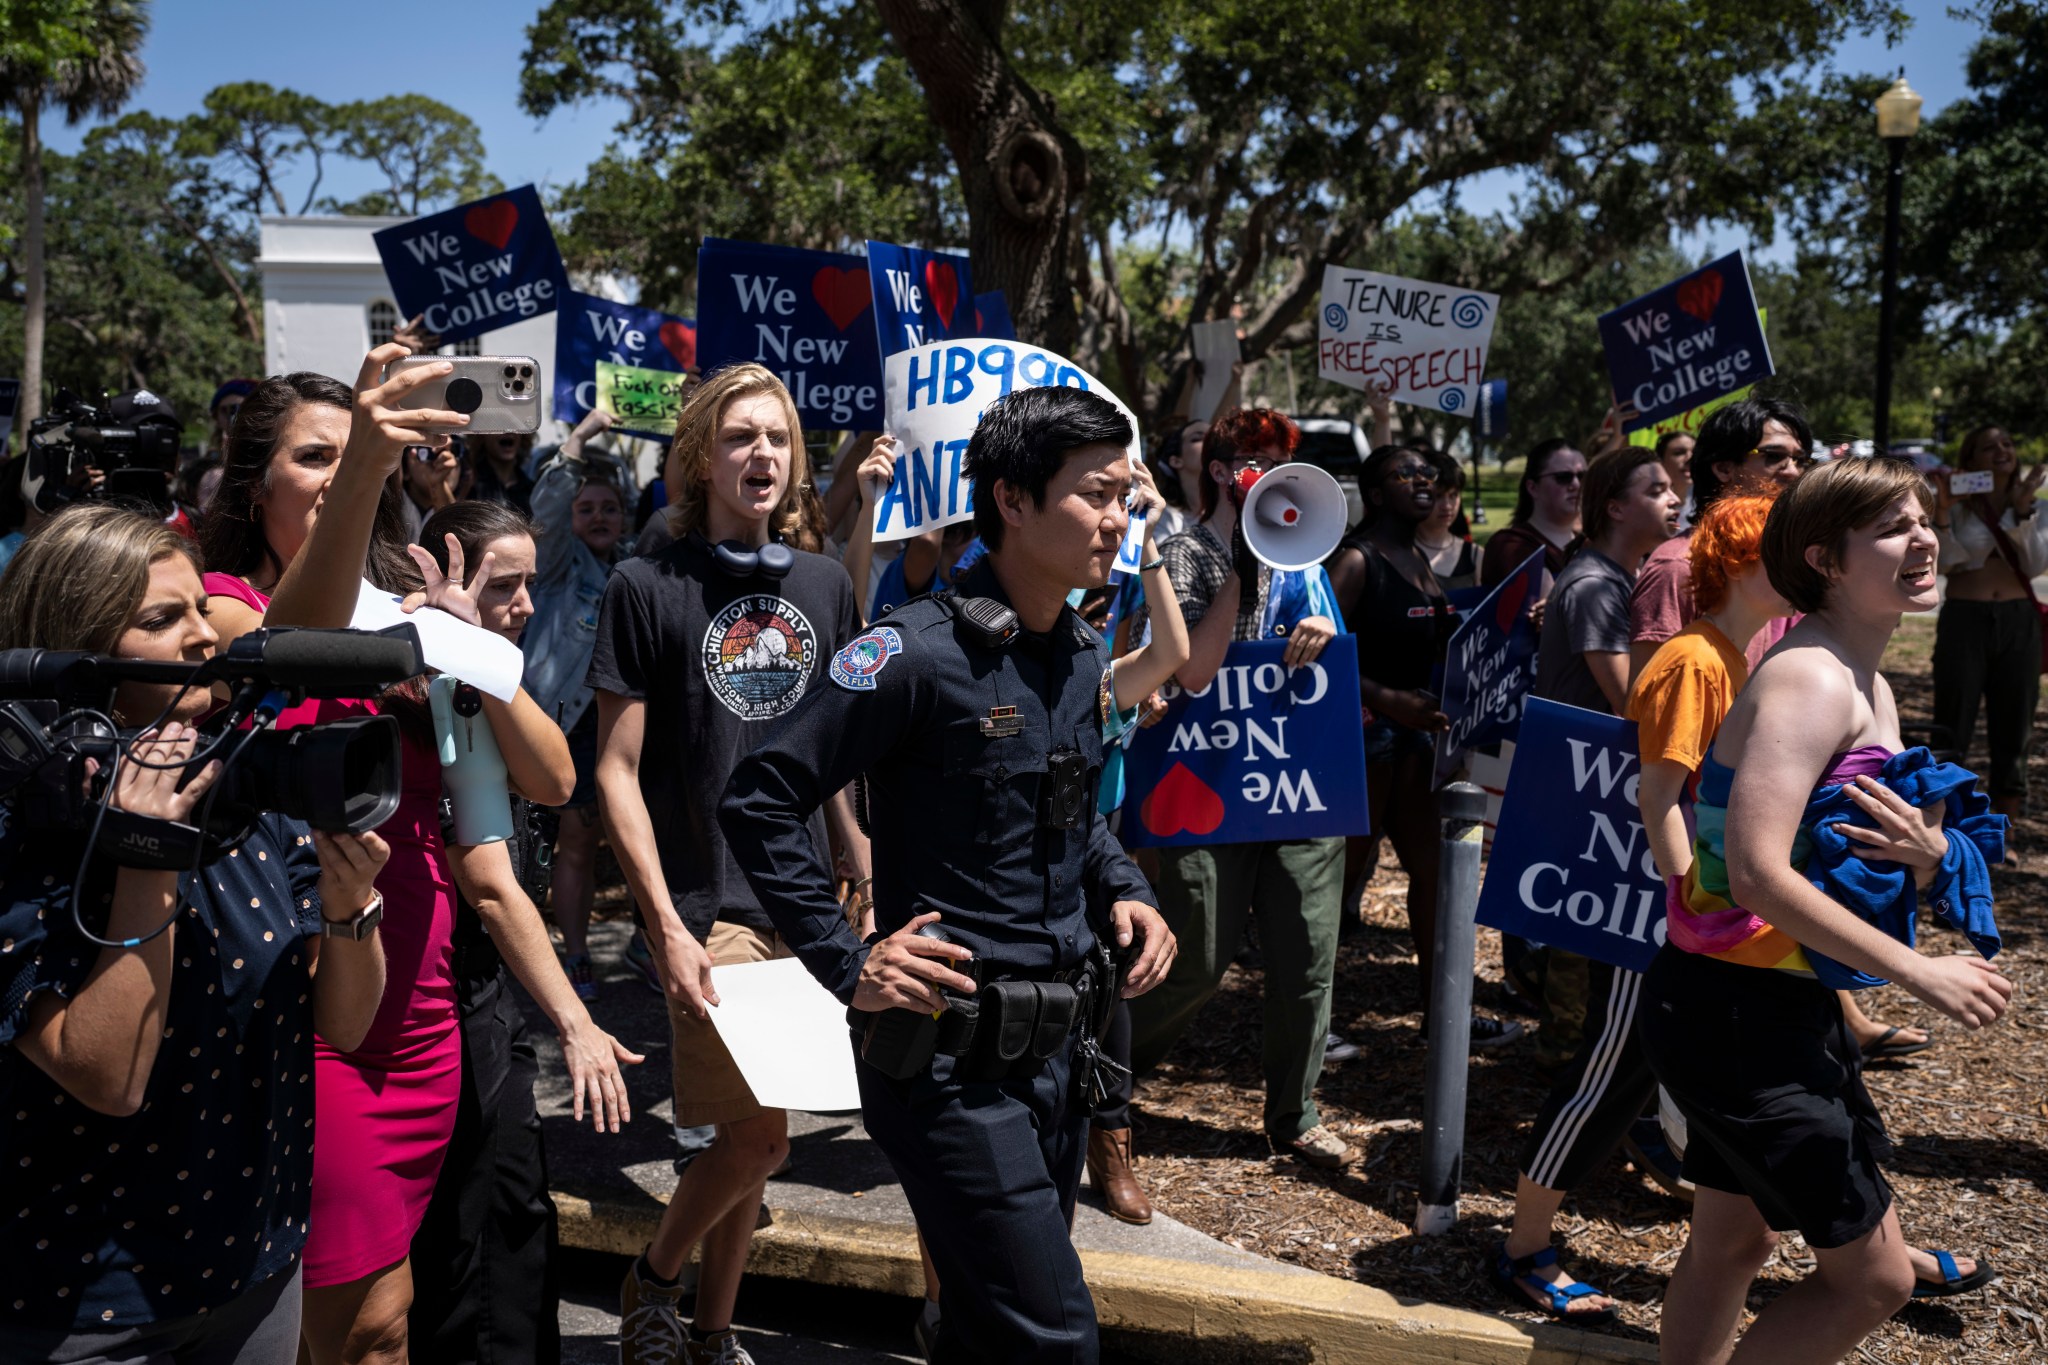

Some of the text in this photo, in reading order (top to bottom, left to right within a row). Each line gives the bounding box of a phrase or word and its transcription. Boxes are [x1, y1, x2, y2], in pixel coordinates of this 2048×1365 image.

[402, 230, 460, 266] We
[434, 253, 513, 295] New
[730, 273, 796, 315] We
[885, 269, 922, 314] We
[424, 278, 554, 333] College
[1343, 278, 1446, 327] TENURE
[586, 310, 646, 351] We
[754, 323, 849, 365] New
[1367, 322, 1402, 341] IS
[1621, 309, 1671, 345] We
[1646, 325, 1716, 373] New
[1320, 338, 1481, 393] FREE SPEECH
[1633, 349, 1751, 413] College
[780, 370, 877, 423] llege
[876, 439, 974, 533] ANT
[707, 600, 754, 665] CHIEFTON
[758, 599, 807, 633] SUPPLY
[1461, 624, 1489, 671] We
[715, 664, 746, 706] WELCOM
[754, 700, 779, 711] HIGH
[851, 677, 872, 687] FLA.
[1158, 661, 1328, 711] Coll
[1464, 640, 1511, 705] New
[1445, 665, 1521, 756] College
[1168, 716, 1291, 761] New
[1242, 768, 1327, 814] We
[123, 833, 159, 850] JVC
[1518, 862, 1668, 948] Coll
